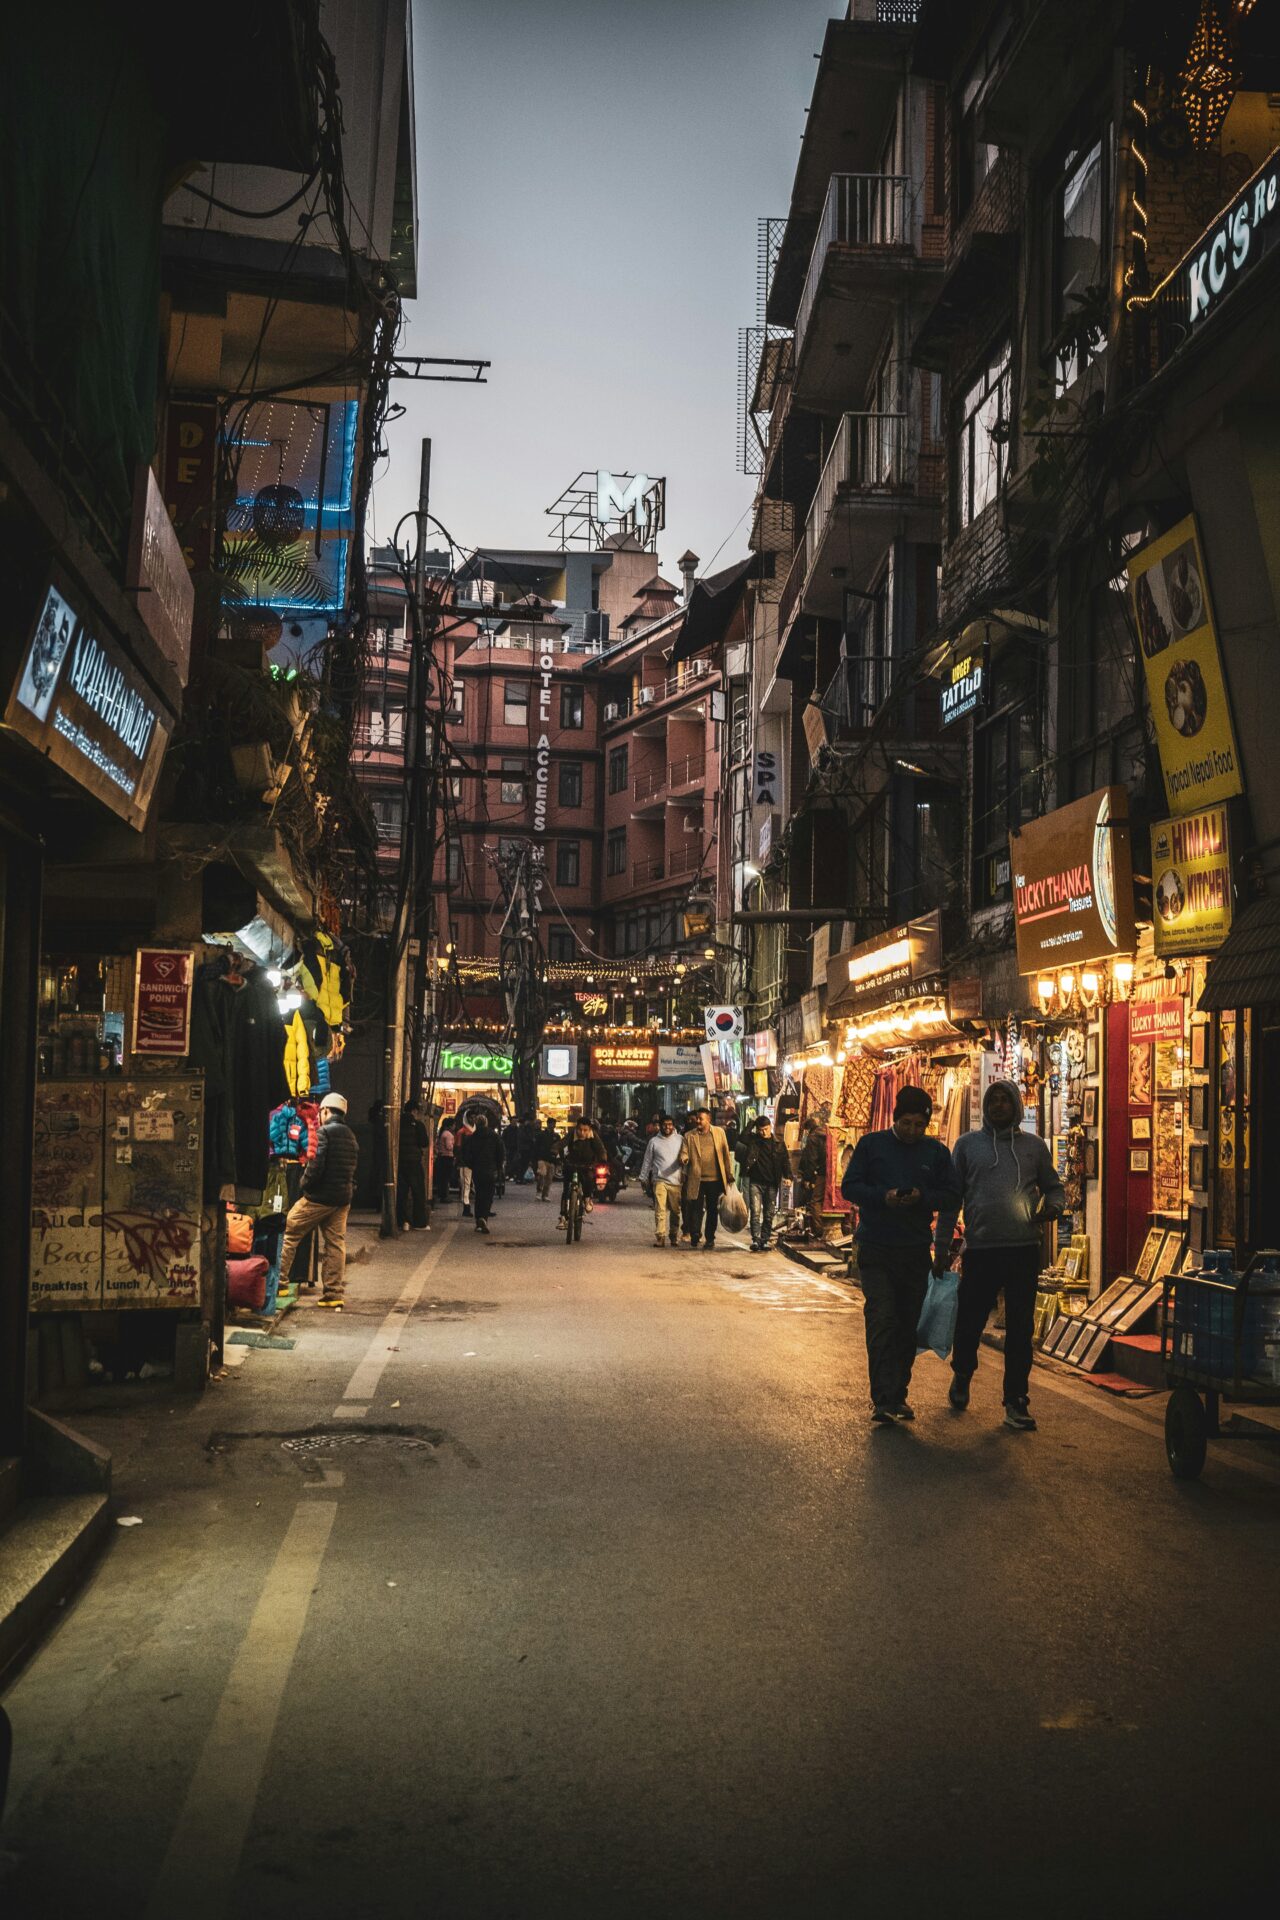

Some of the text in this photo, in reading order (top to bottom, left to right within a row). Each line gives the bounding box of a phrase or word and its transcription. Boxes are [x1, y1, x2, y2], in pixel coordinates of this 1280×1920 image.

[1188, 201, 1250, 323] KC'S
[539, 637, 553, 722] HOTEL
[942, 666, 982, 713] TATTOO
[534, 733, 551, 832] ACCESS
[757, 753, 777, 806] SPA
[1165, 745, 1234, 800] Typical Nepali Food
[1171, 811, 1227, 864] HIMALI
[1015, 874, 1025, 888] New
[1016, 864, 1092, 914] LUCKY THANKA
[1069, 896, 1092, 912] Treasures
[1187, 867, 1229, 913] KITCHEN
[140, 984, 188, 993] SANDWICH
[149, 994, 177, 1003] POINT
[1131, 1010, 1181, 1032] LUCKY THANKA
[595, 1049, 614, 1058] BON
[33, 1279, 89, 1292] Breakfast
[106, 1279, 141, 1291] Lunch
